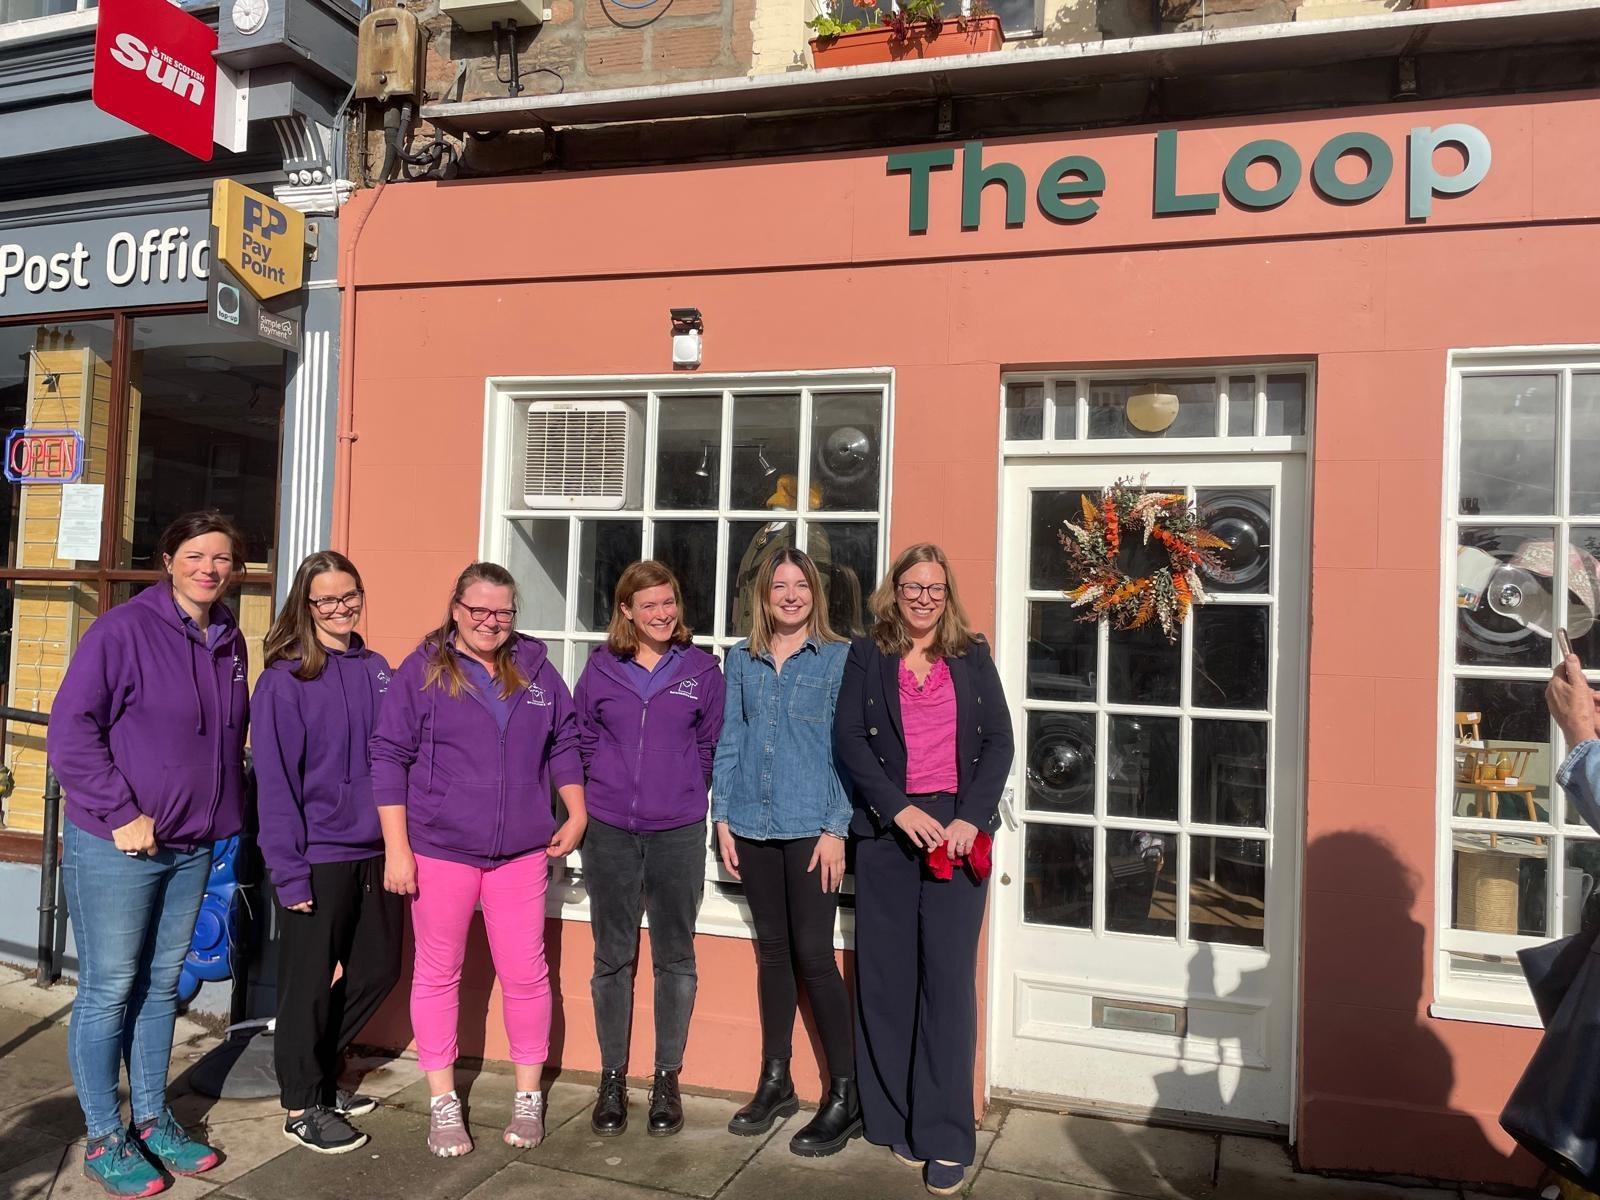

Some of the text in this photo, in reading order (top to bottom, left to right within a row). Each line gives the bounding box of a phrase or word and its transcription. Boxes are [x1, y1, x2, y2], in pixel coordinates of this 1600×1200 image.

[109, 33, 205, 106] Sun
[160, 52, 205, 83] THE SCOTTISH
[886, 123, 1492, 232] The Loop
[0, 226, 210, 296] Post Offic
[242, 232, 272, 263] Pay
[241, 252, 286, 285] Point
[260, 315, 282, 330] Simple
[260, 323, 288, 340] Payment
[11, 437, 77, 474] OPEN
